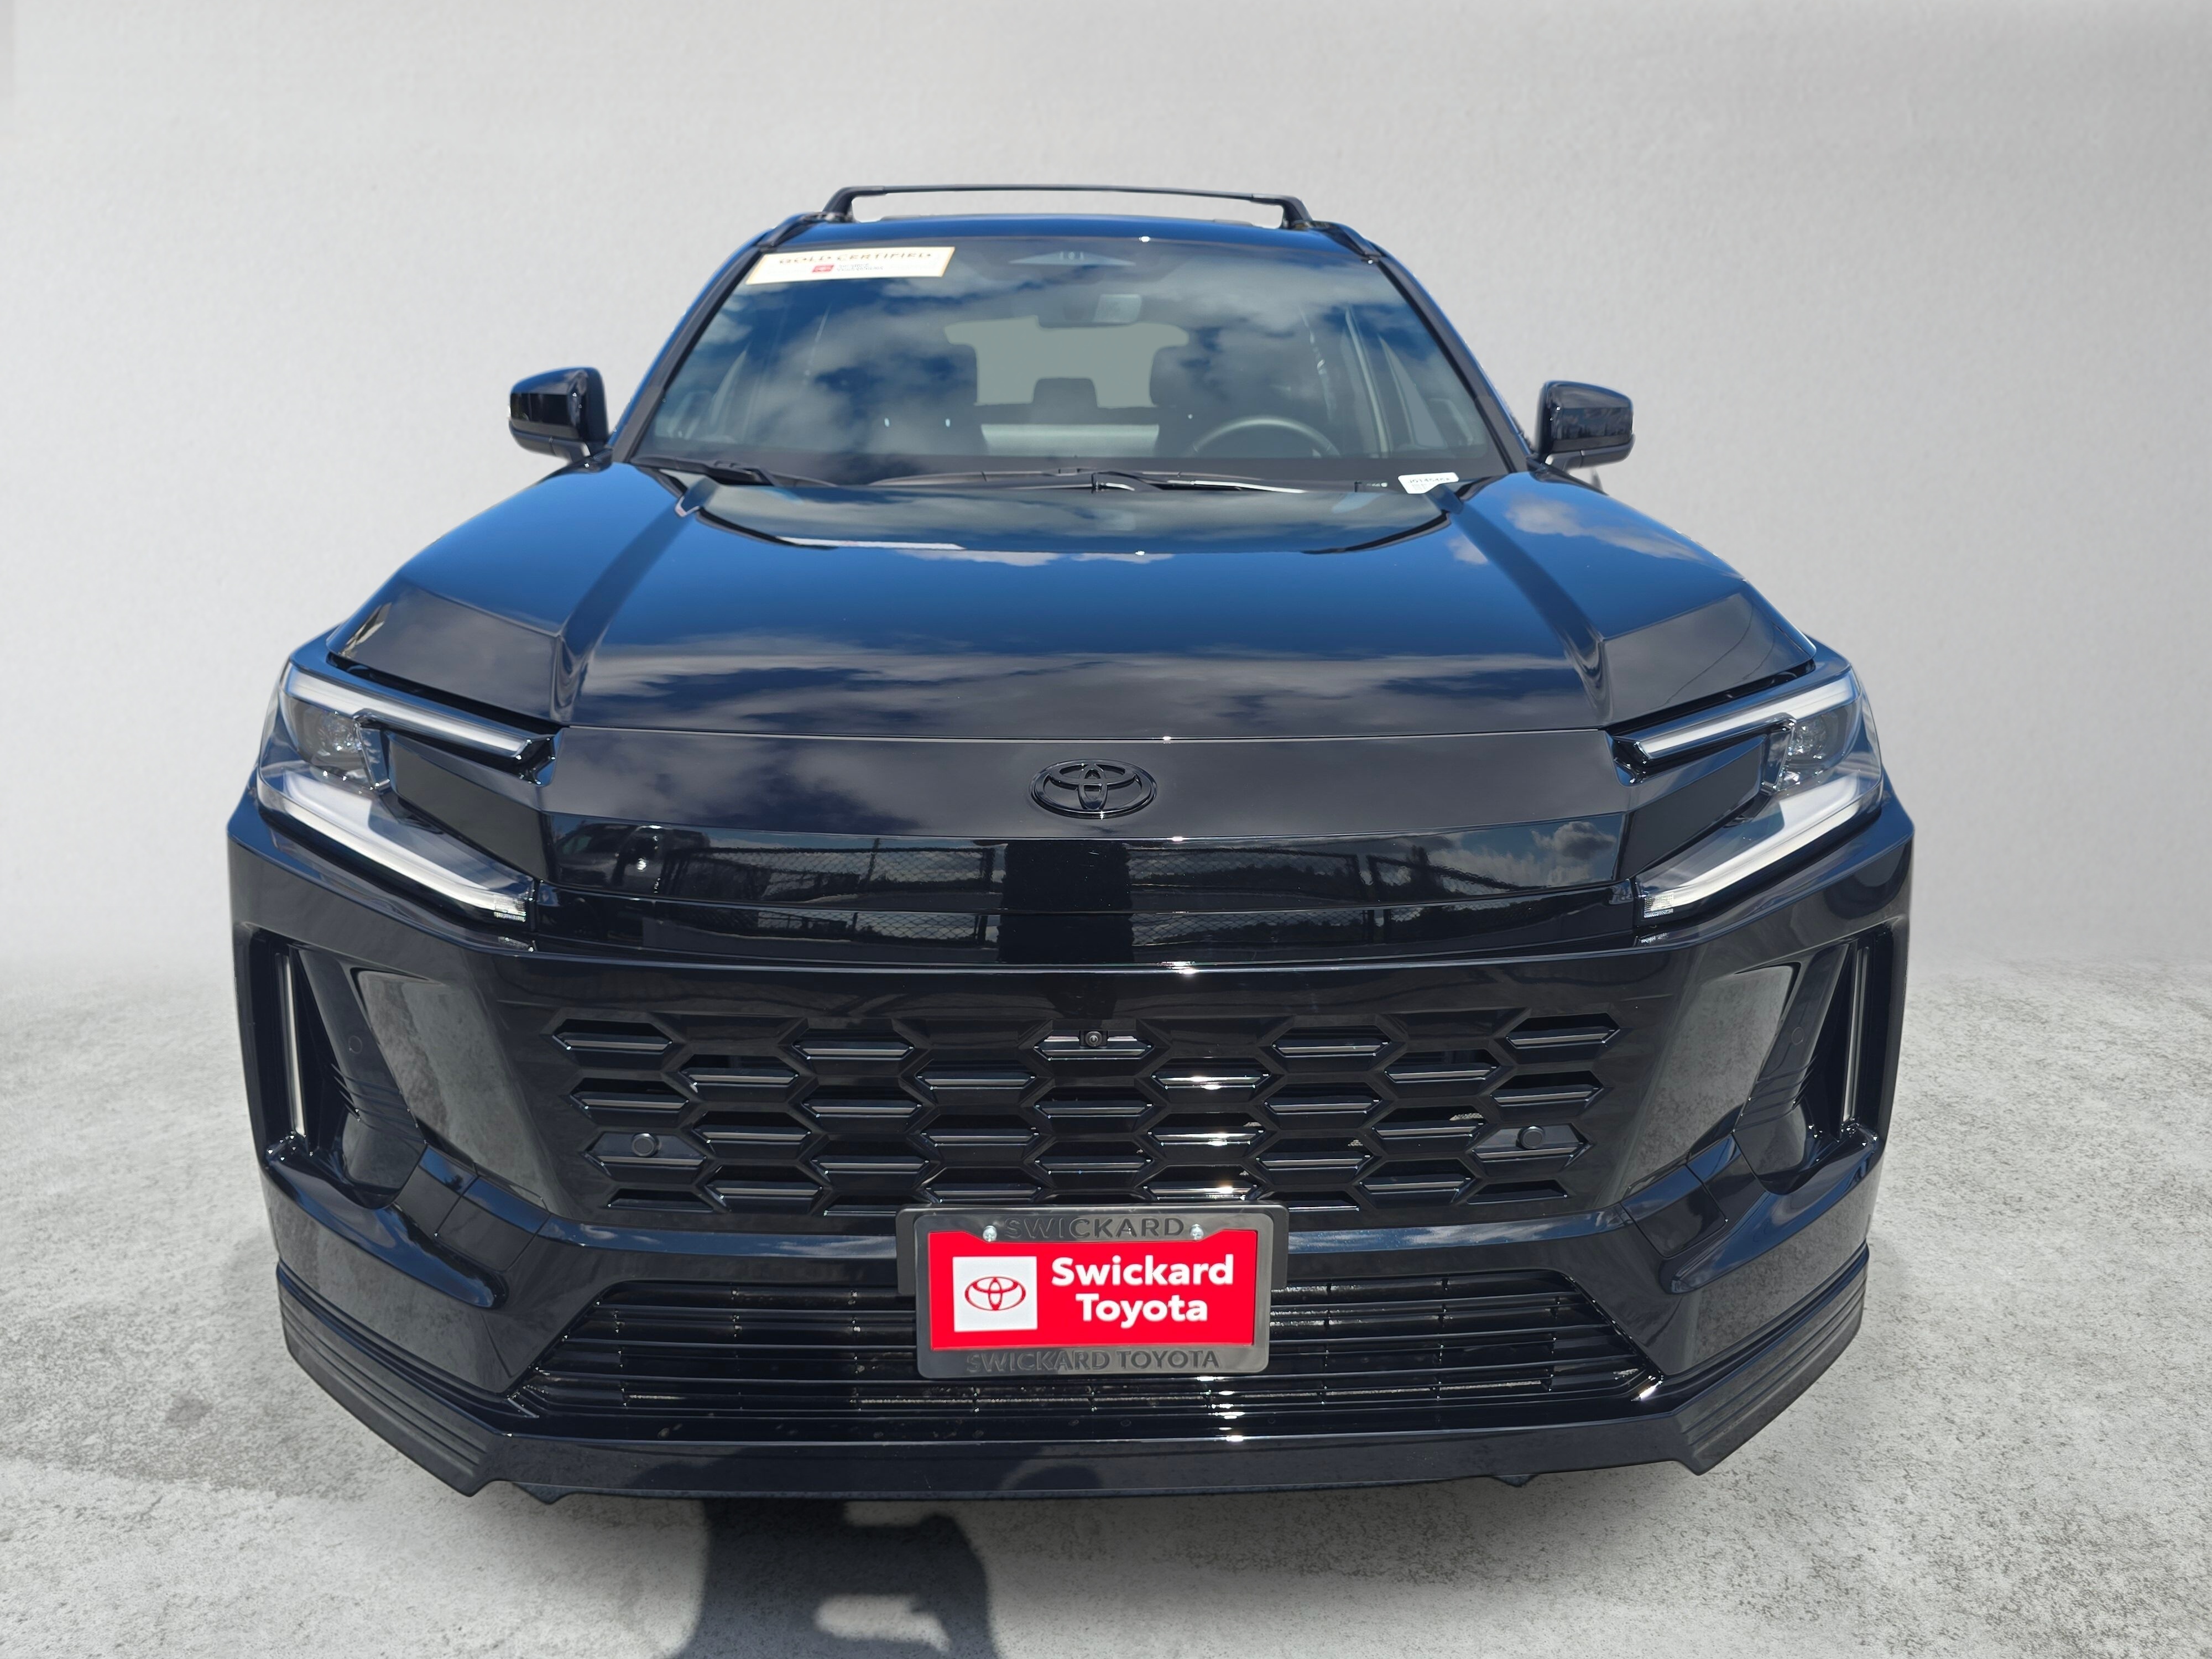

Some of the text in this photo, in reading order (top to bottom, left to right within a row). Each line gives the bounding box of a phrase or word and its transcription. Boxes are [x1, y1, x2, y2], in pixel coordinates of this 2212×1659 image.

[1005, 1217, 1185, 1239] SWICKARD
[1051, 1254, 1234, 1286] Swickard
[1075, 1293, 1208, 1329] Toyota
[966, 1349, 1220, 1373] SWICKARD TOYOTA
